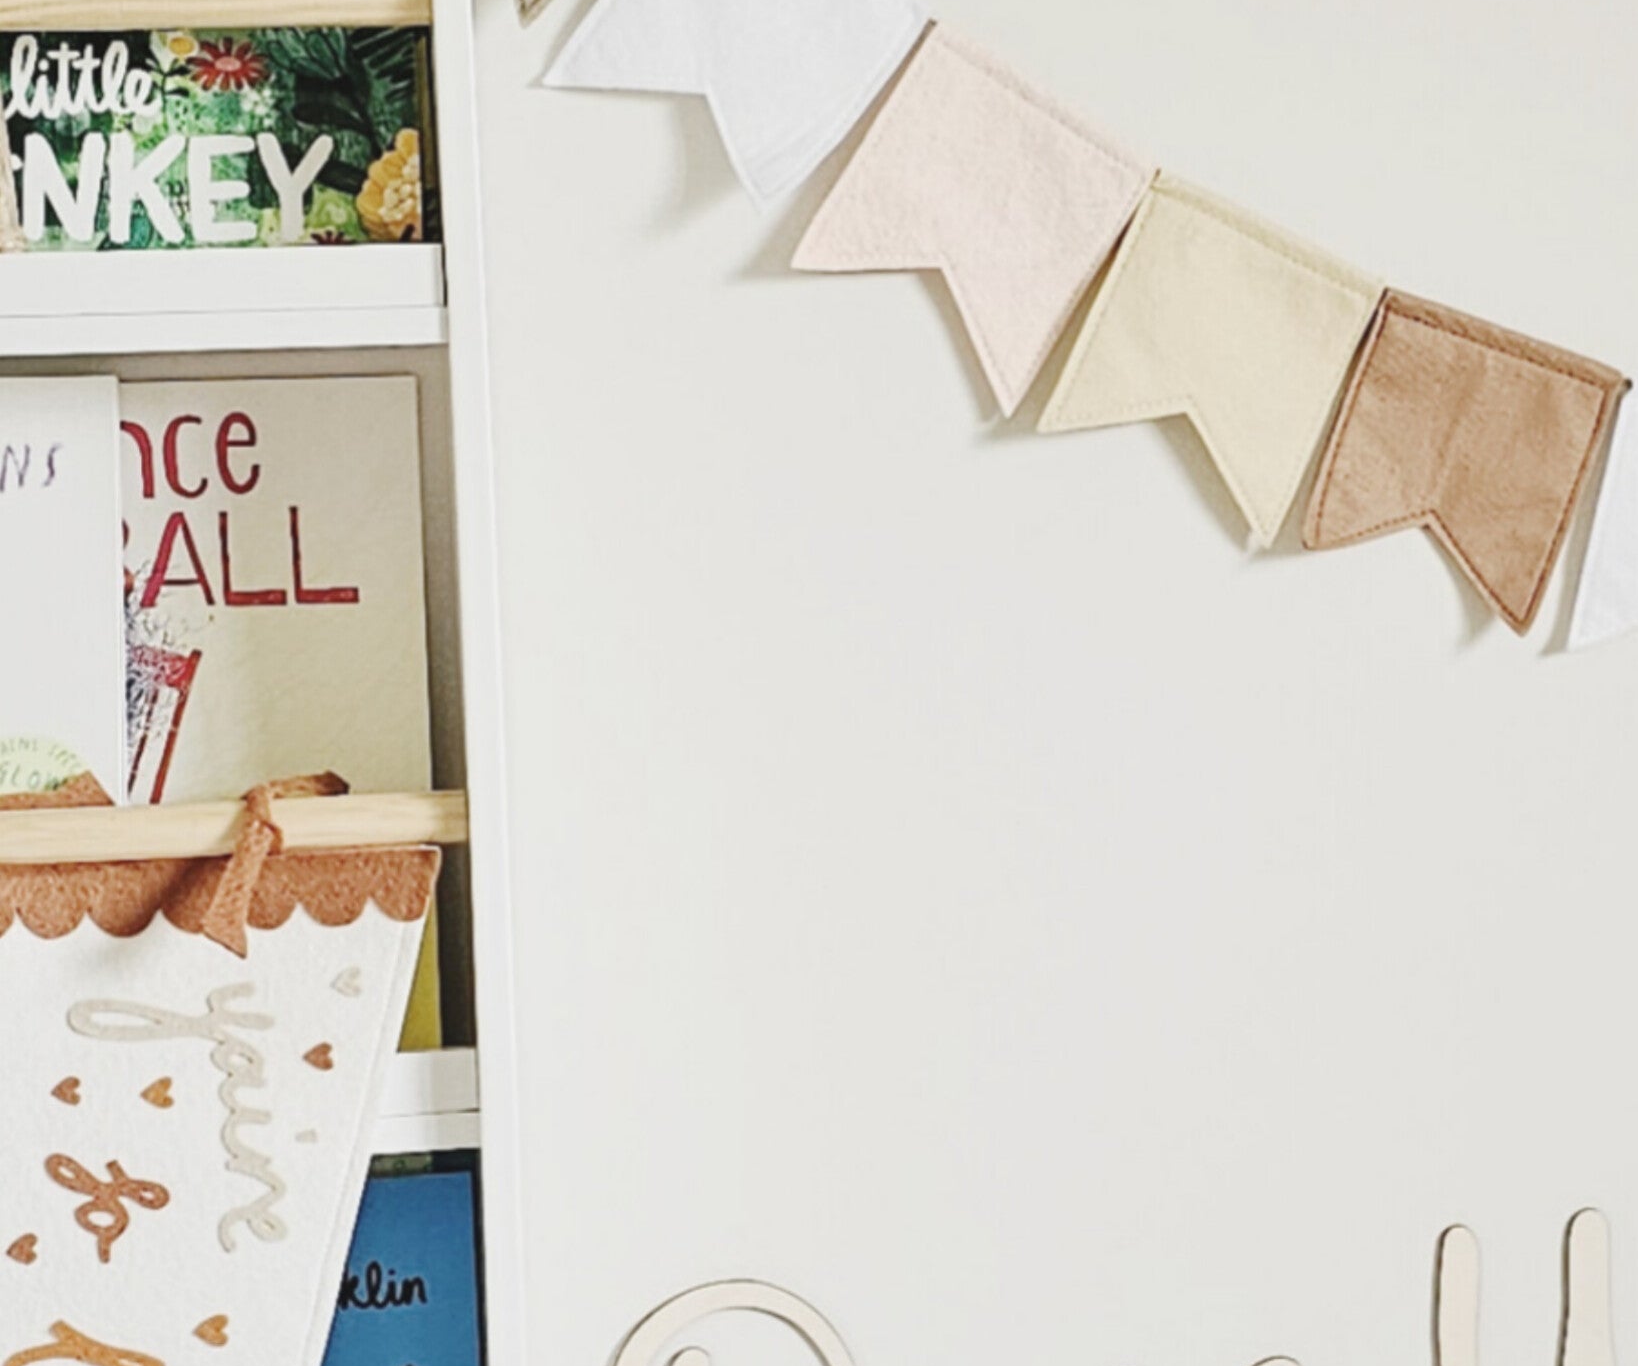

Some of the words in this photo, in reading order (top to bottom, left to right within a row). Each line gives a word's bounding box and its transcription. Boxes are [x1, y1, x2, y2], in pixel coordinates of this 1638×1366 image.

[6, 34, 161, 120] little
[11, 132, 334, 244] NKEY
[121, 505, 360, 609] ALL
[337, 1259, 428, 1311] klin
